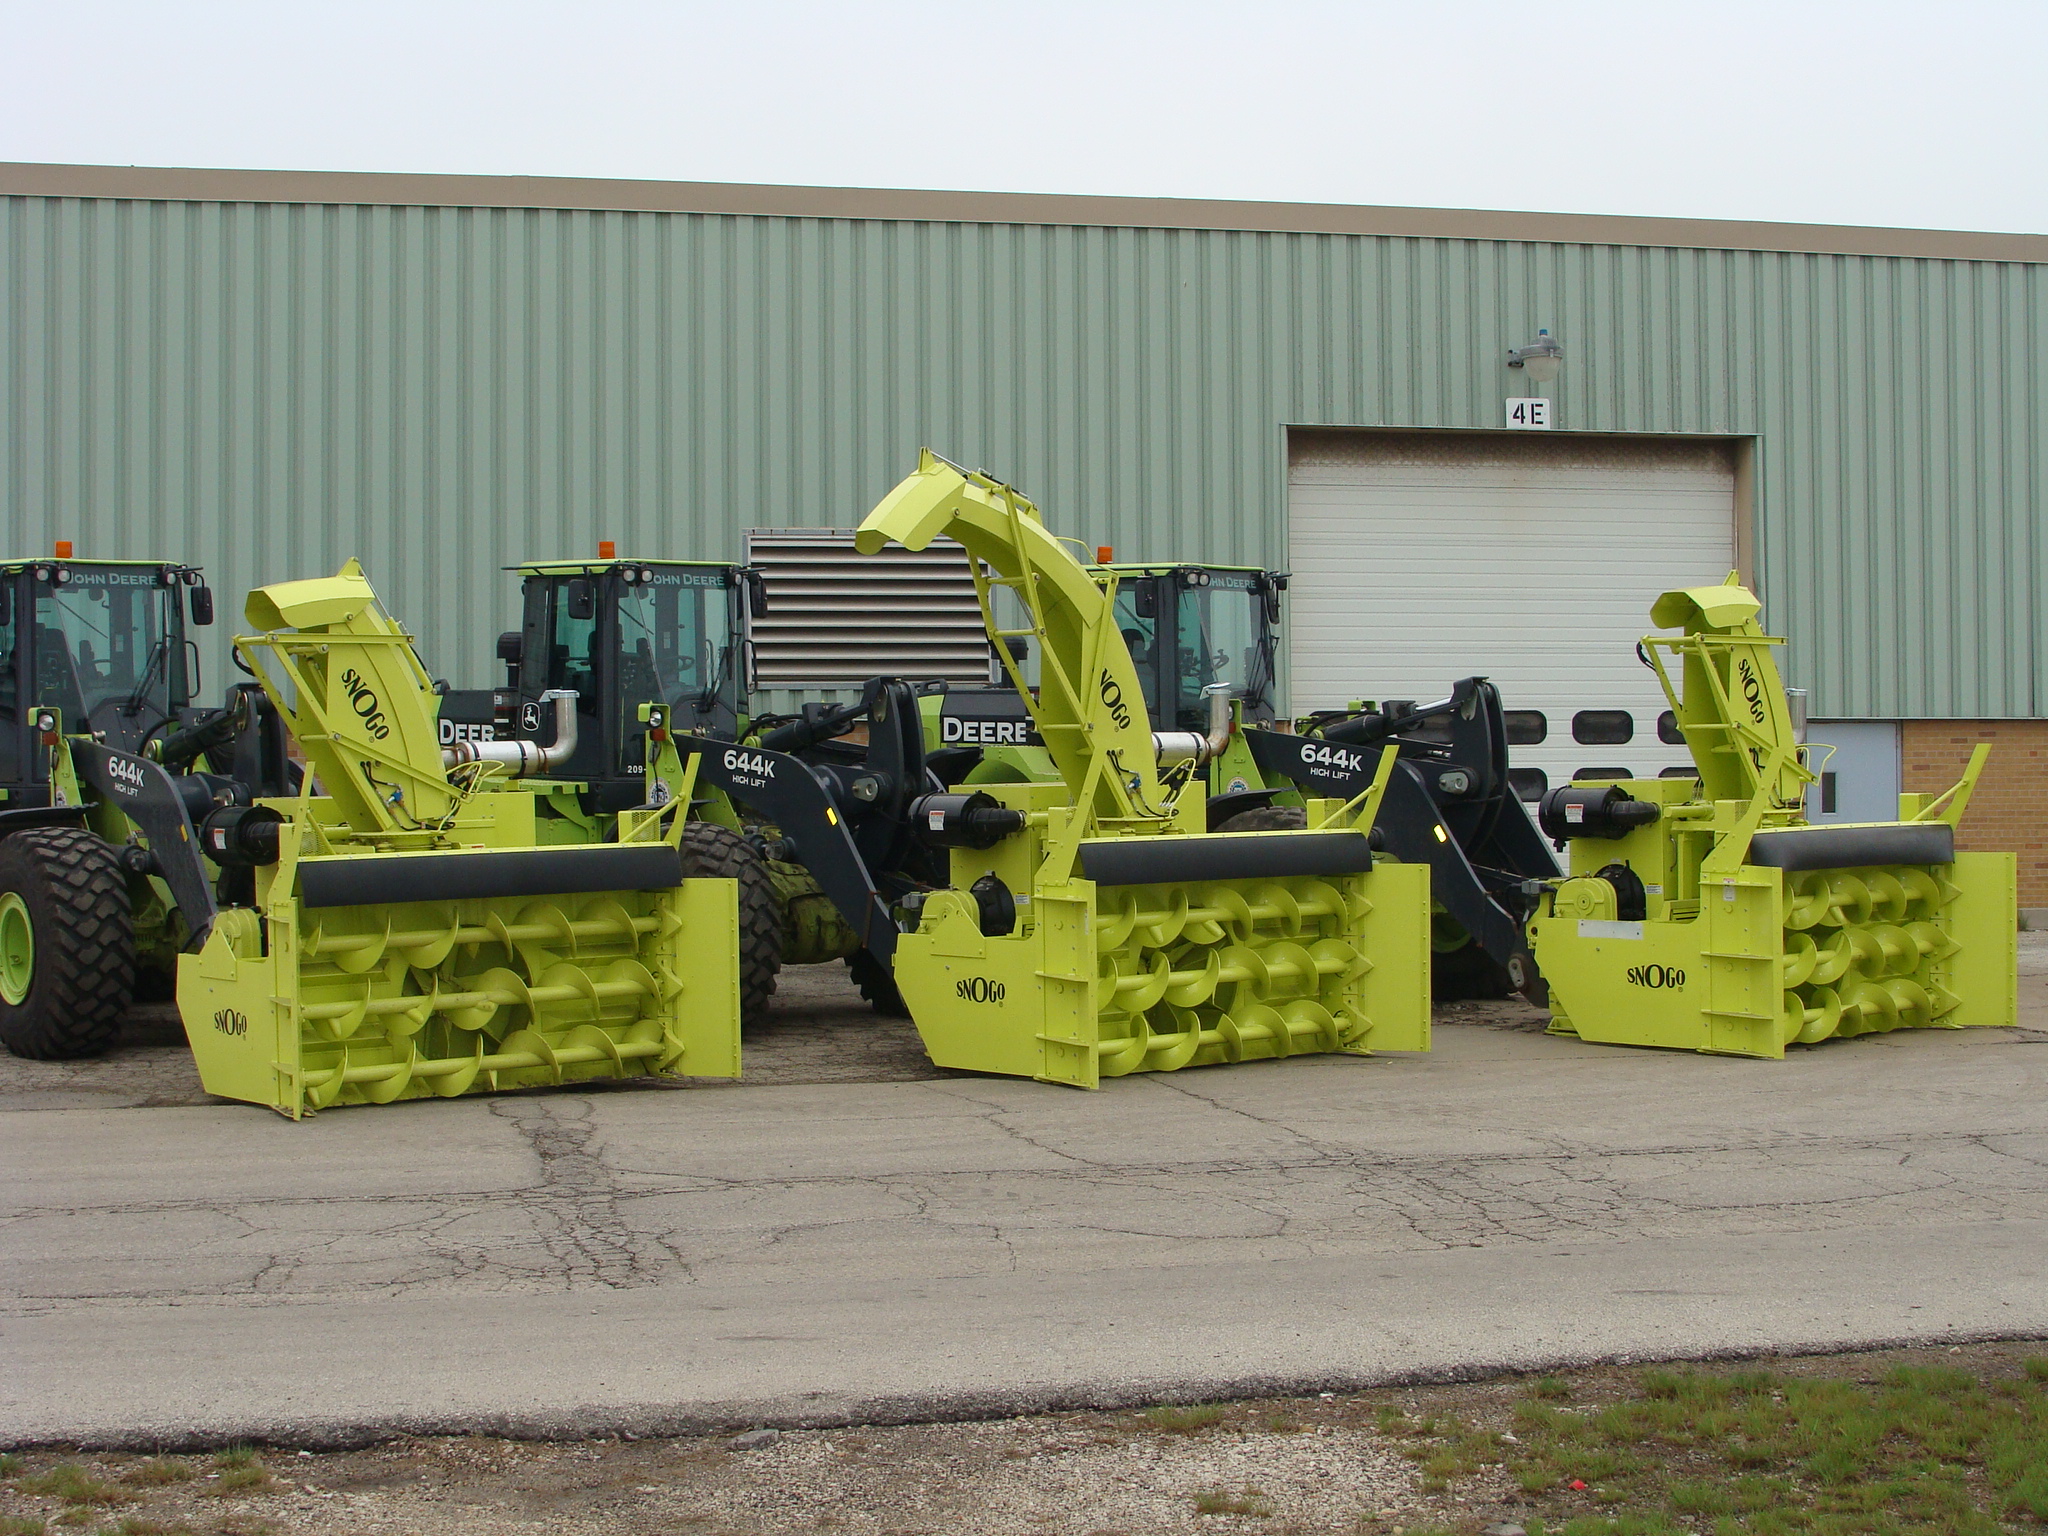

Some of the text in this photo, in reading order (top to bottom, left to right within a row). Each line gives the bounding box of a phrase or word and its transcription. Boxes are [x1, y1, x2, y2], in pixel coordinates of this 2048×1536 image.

[1512, 402, 1544, 425] 4E
[108, 573, 158, 585] DEERE
[648, 573, 725, 586] OHN DEERE
[1226, 576, 1257, 589] DEERE
[341, 668, 390, 740] SNOGO
[1100, 667, 1131, 730] NOGO
[1738, 658, 1765, 724] SNOGO
[439, 718, 495, 744] DEER
[943, 717, 1027, 743] DEERE
[723, 749, 776, 779] 644K
[1300, 743, 1363, 772] 644K
[108, 755, 145, 788] 644K
[732, 774, 766, 789] HIGH LIFT
[1310, 767, 1351, 781] HIGH LIFT
[114, 782, 139, 798] HIGH LIFT
[956, 976, 1006, 1003] SNOGO
[1626, 964, 1686, 989] SNOGO
[214, 1008, 248, 1036] SNOGO
